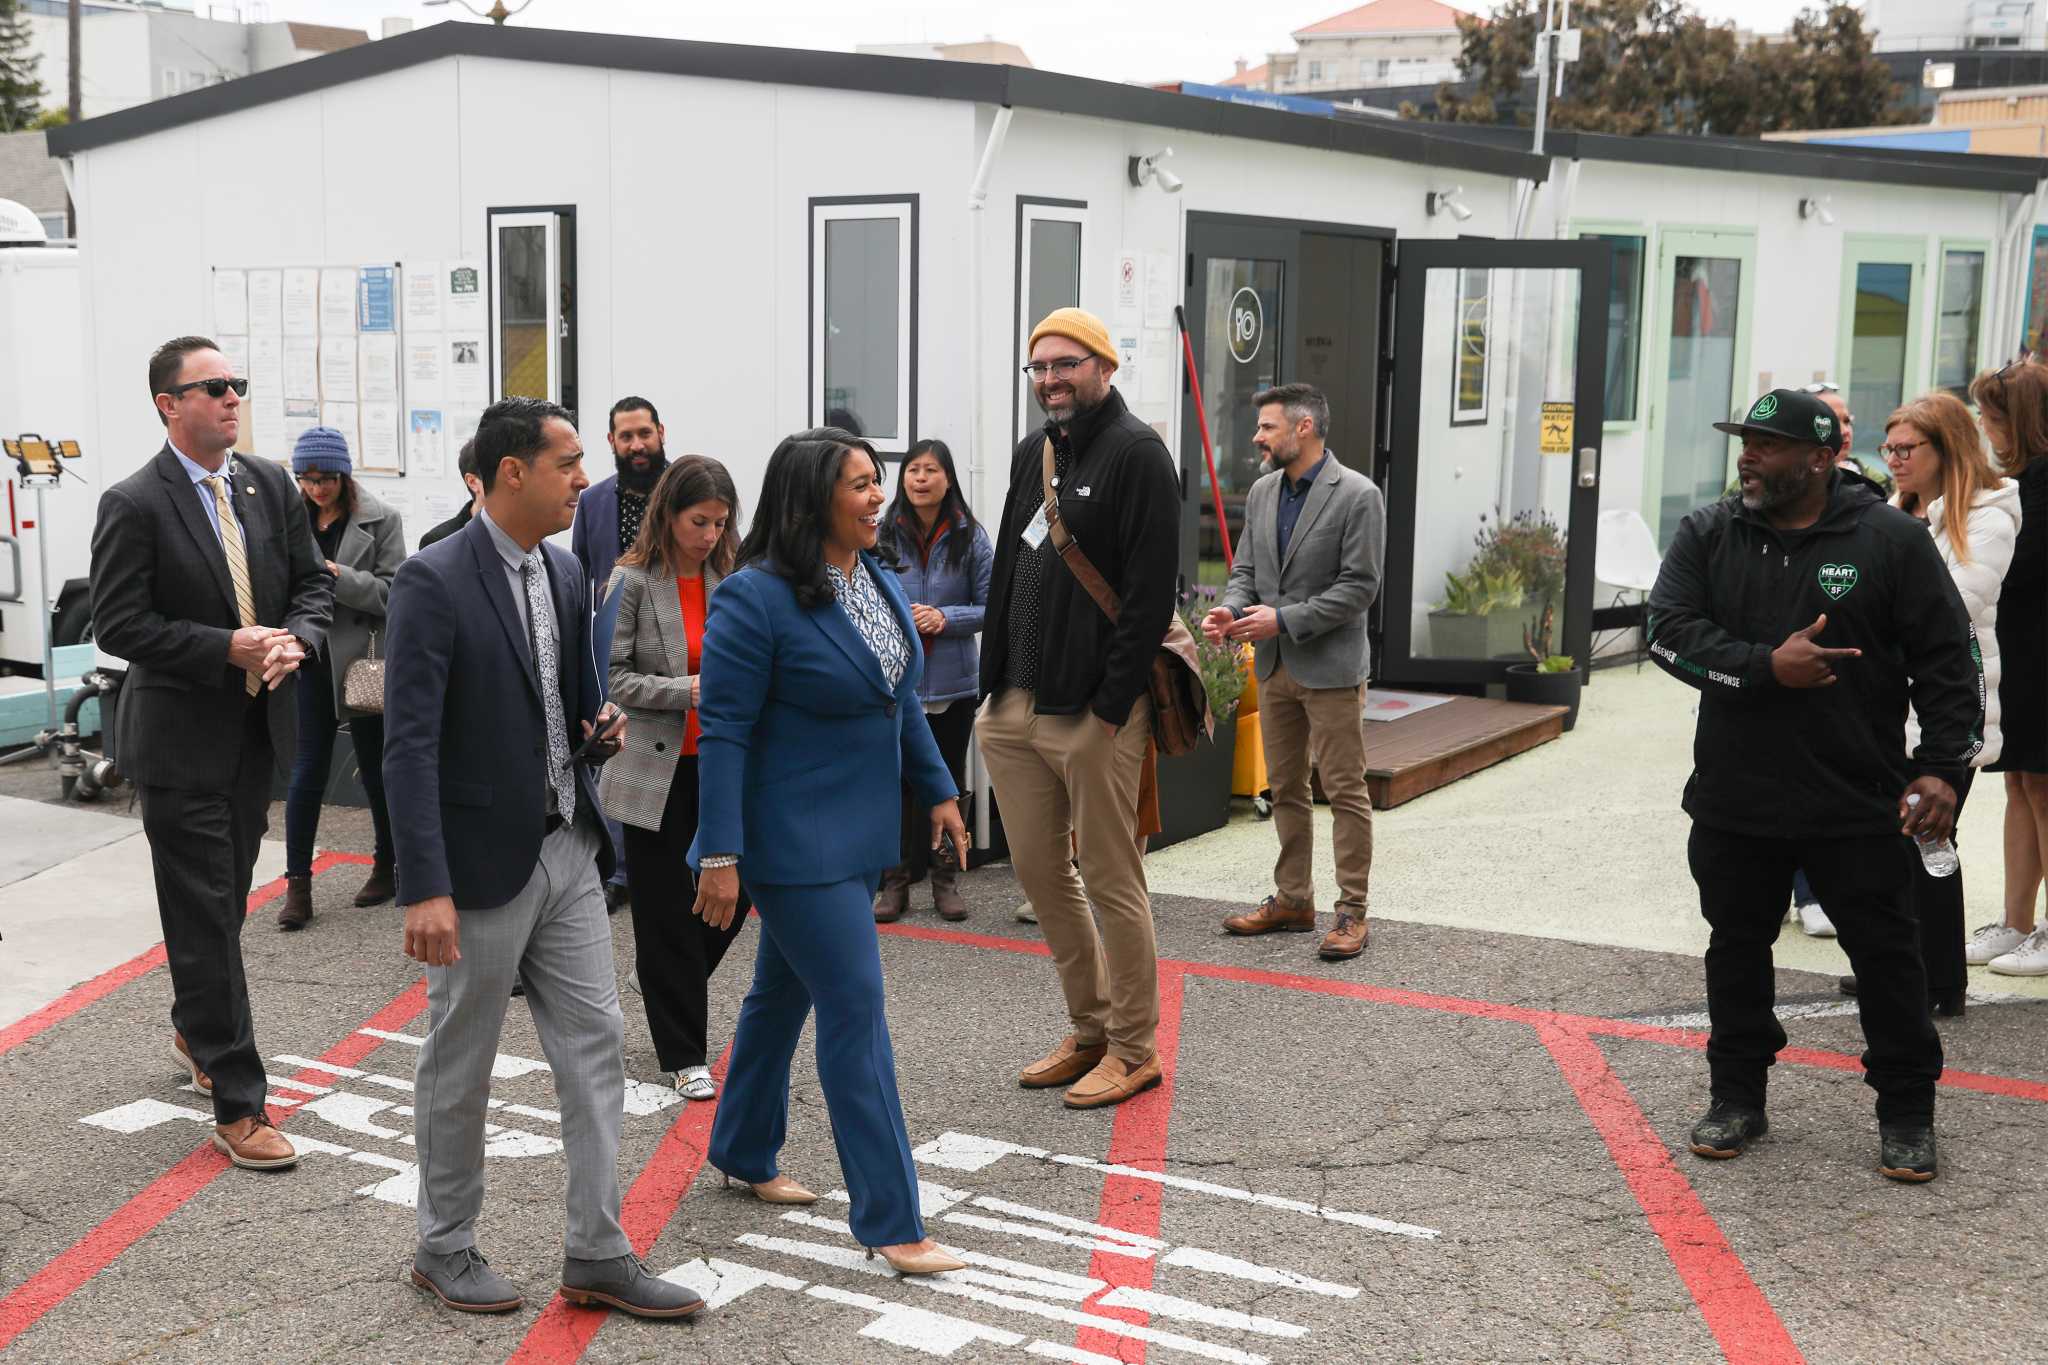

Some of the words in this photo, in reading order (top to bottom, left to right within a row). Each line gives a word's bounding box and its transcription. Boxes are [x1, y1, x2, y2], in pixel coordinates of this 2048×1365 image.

[1822, 567, 1855, 577] HEART
[1831, 586, 1842, 594] SF
[1708, 670, 1740, 688] RESPONSE
